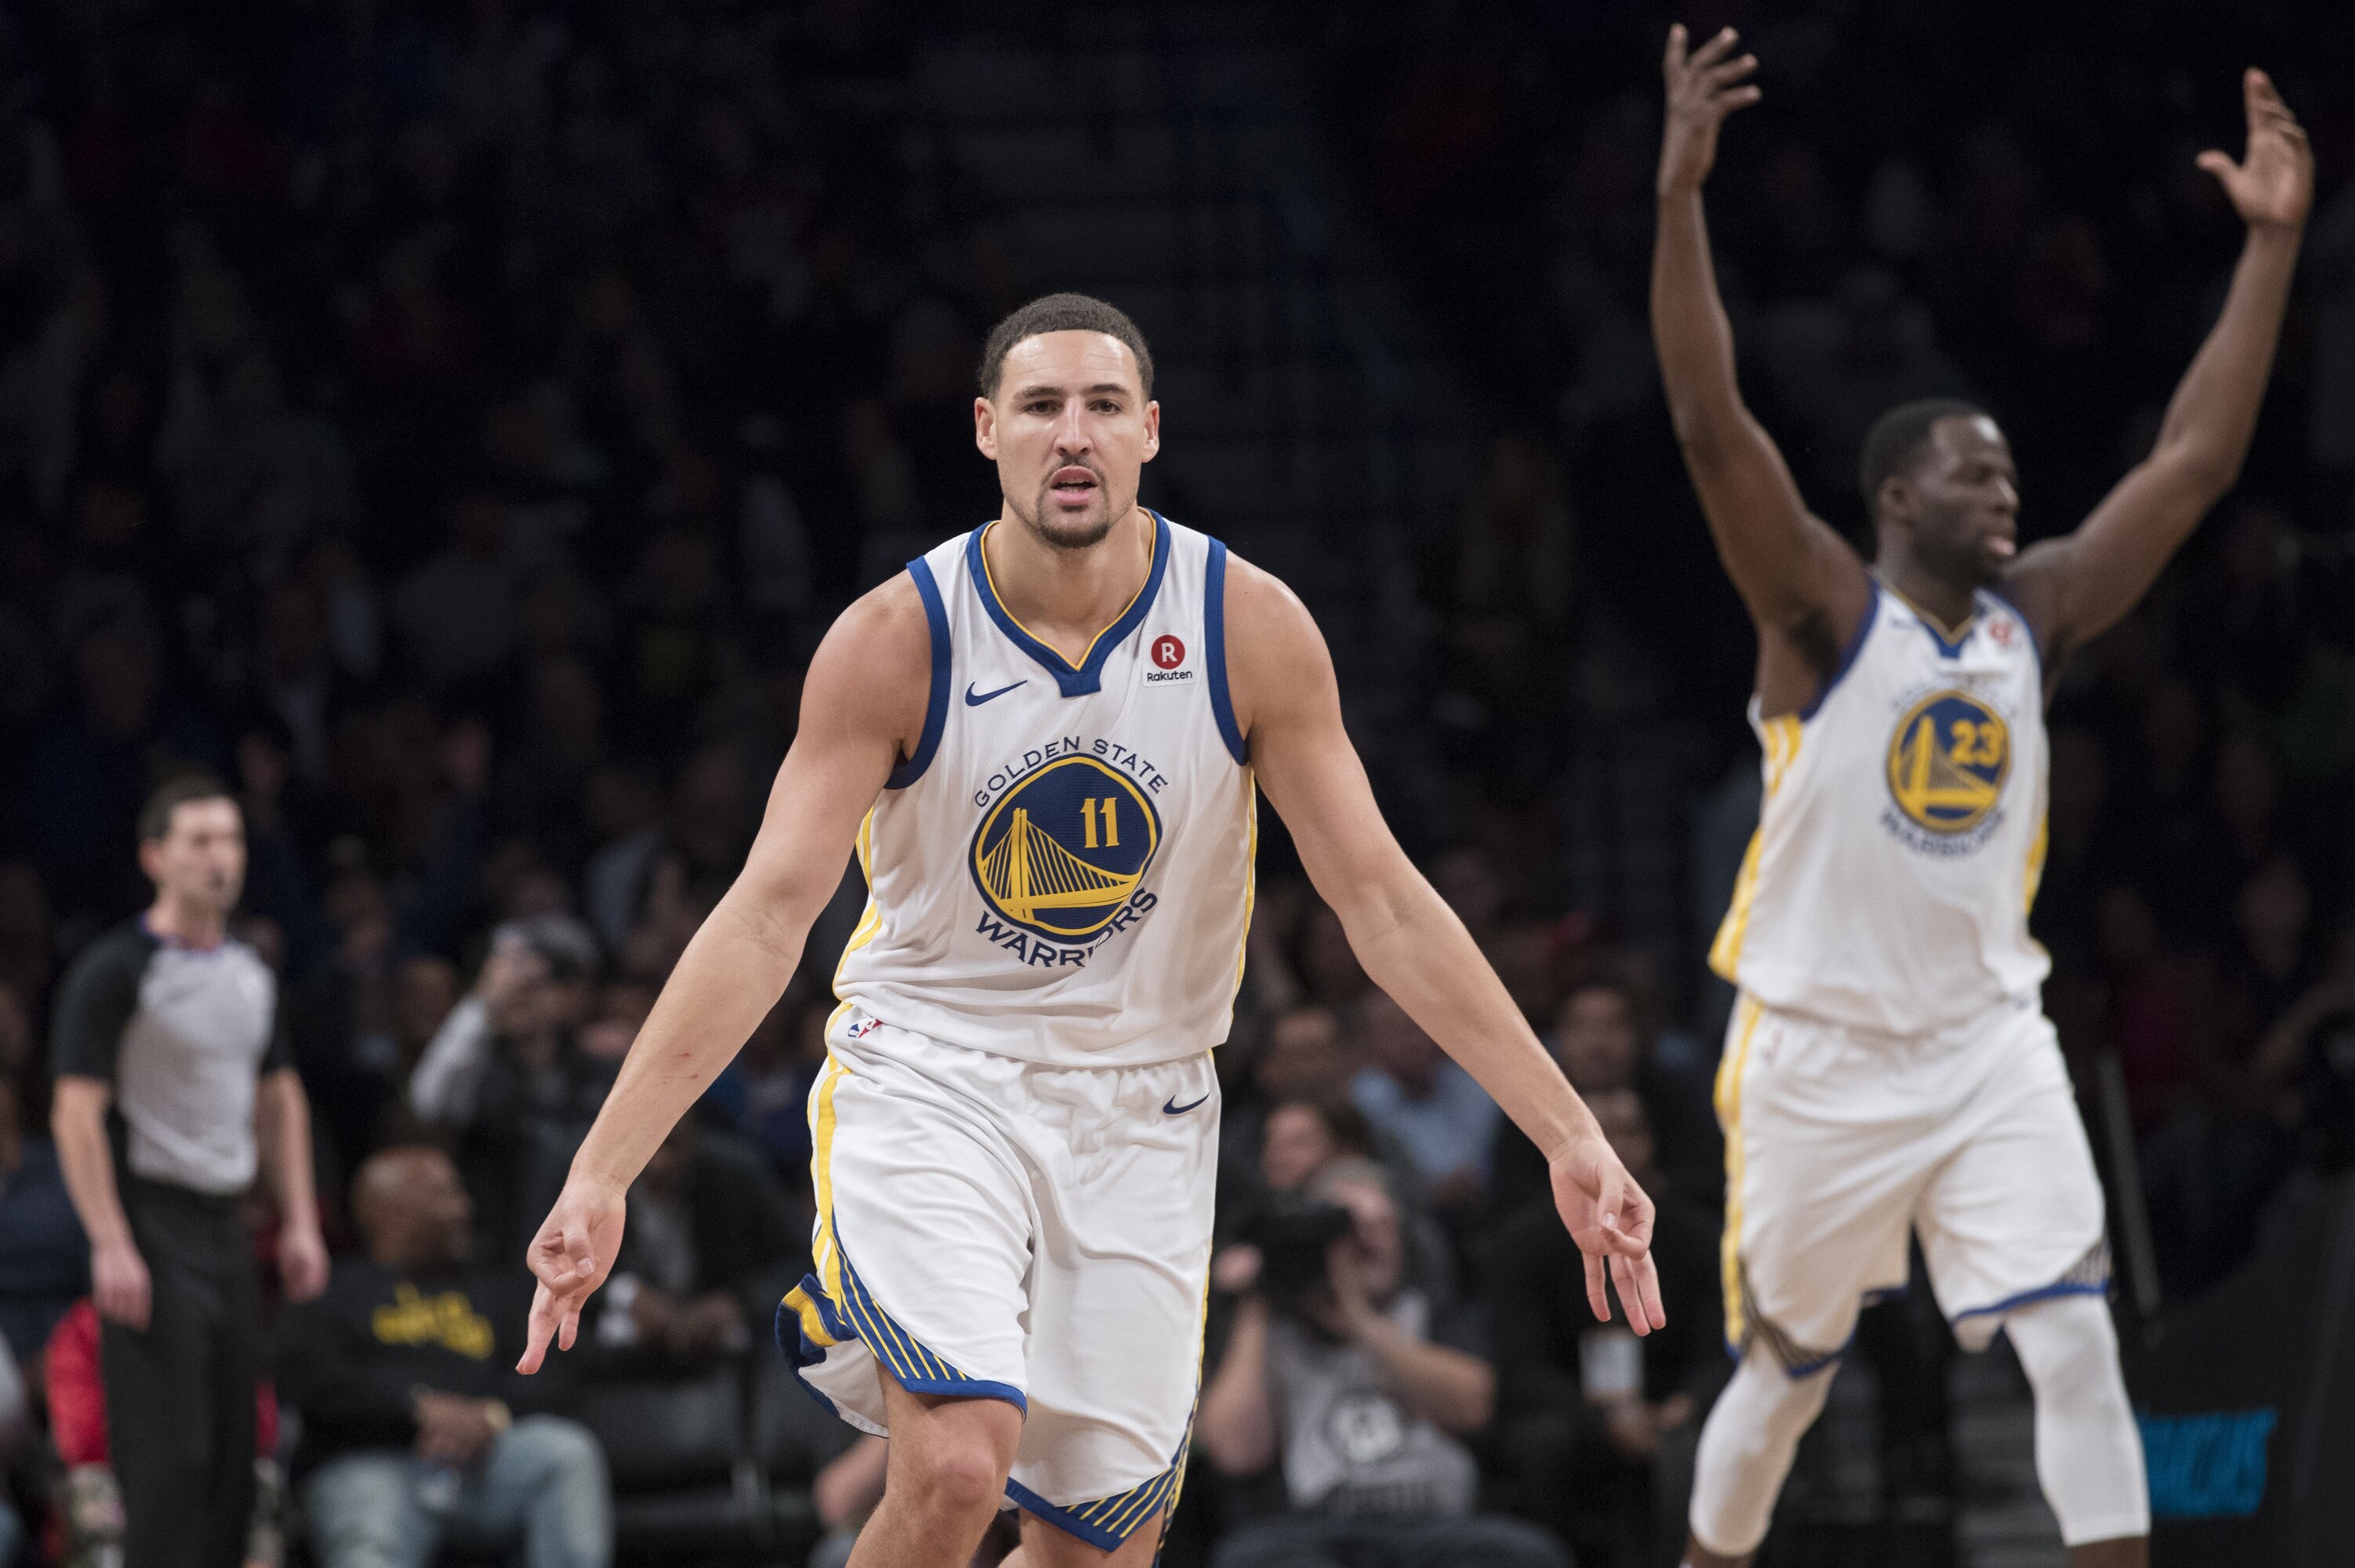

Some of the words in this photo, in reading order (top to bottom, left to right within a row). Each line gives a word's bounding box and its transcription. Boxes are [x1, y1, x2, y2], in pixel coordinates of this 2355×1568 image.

[1147, 670, 1192, 681] Rakuten
[1161, 642, 1178, 662] R
[1951, 720, 2000, 767] 23
[974, 736, 1080, 808] GOLDEN
[1093, 739, 1169, 793] STATE
[1080, 797, 1119, 848] 11
